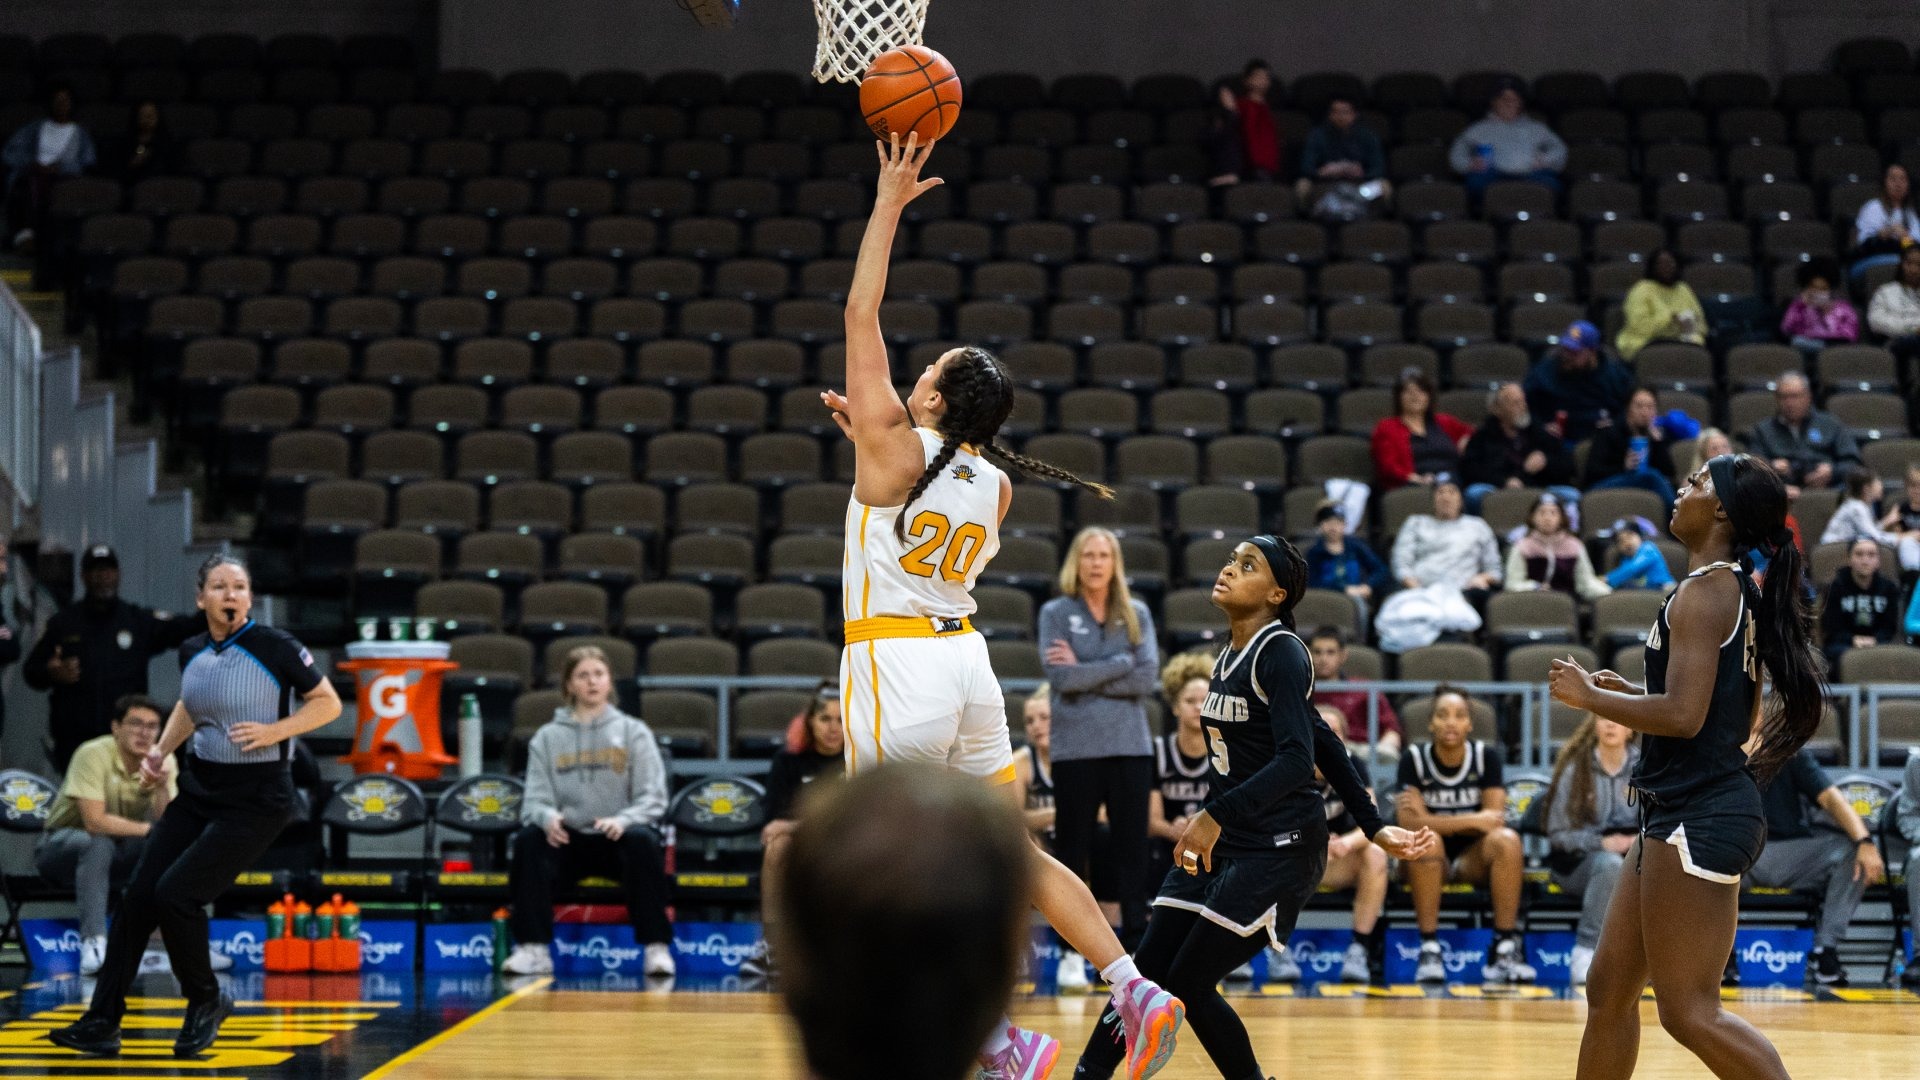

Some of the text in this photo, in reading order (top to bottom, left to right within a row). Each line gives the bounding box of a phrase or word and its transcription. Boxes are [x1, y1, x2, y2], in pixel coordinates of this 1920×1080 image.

[899, 510, 987, 583] 20
[369, 675, 407, 718] G
[1206, 726, 1230, 776] 5
[578, 936, 641, 969] Kroger
[1743, 940, 1804, 973] Kroger
